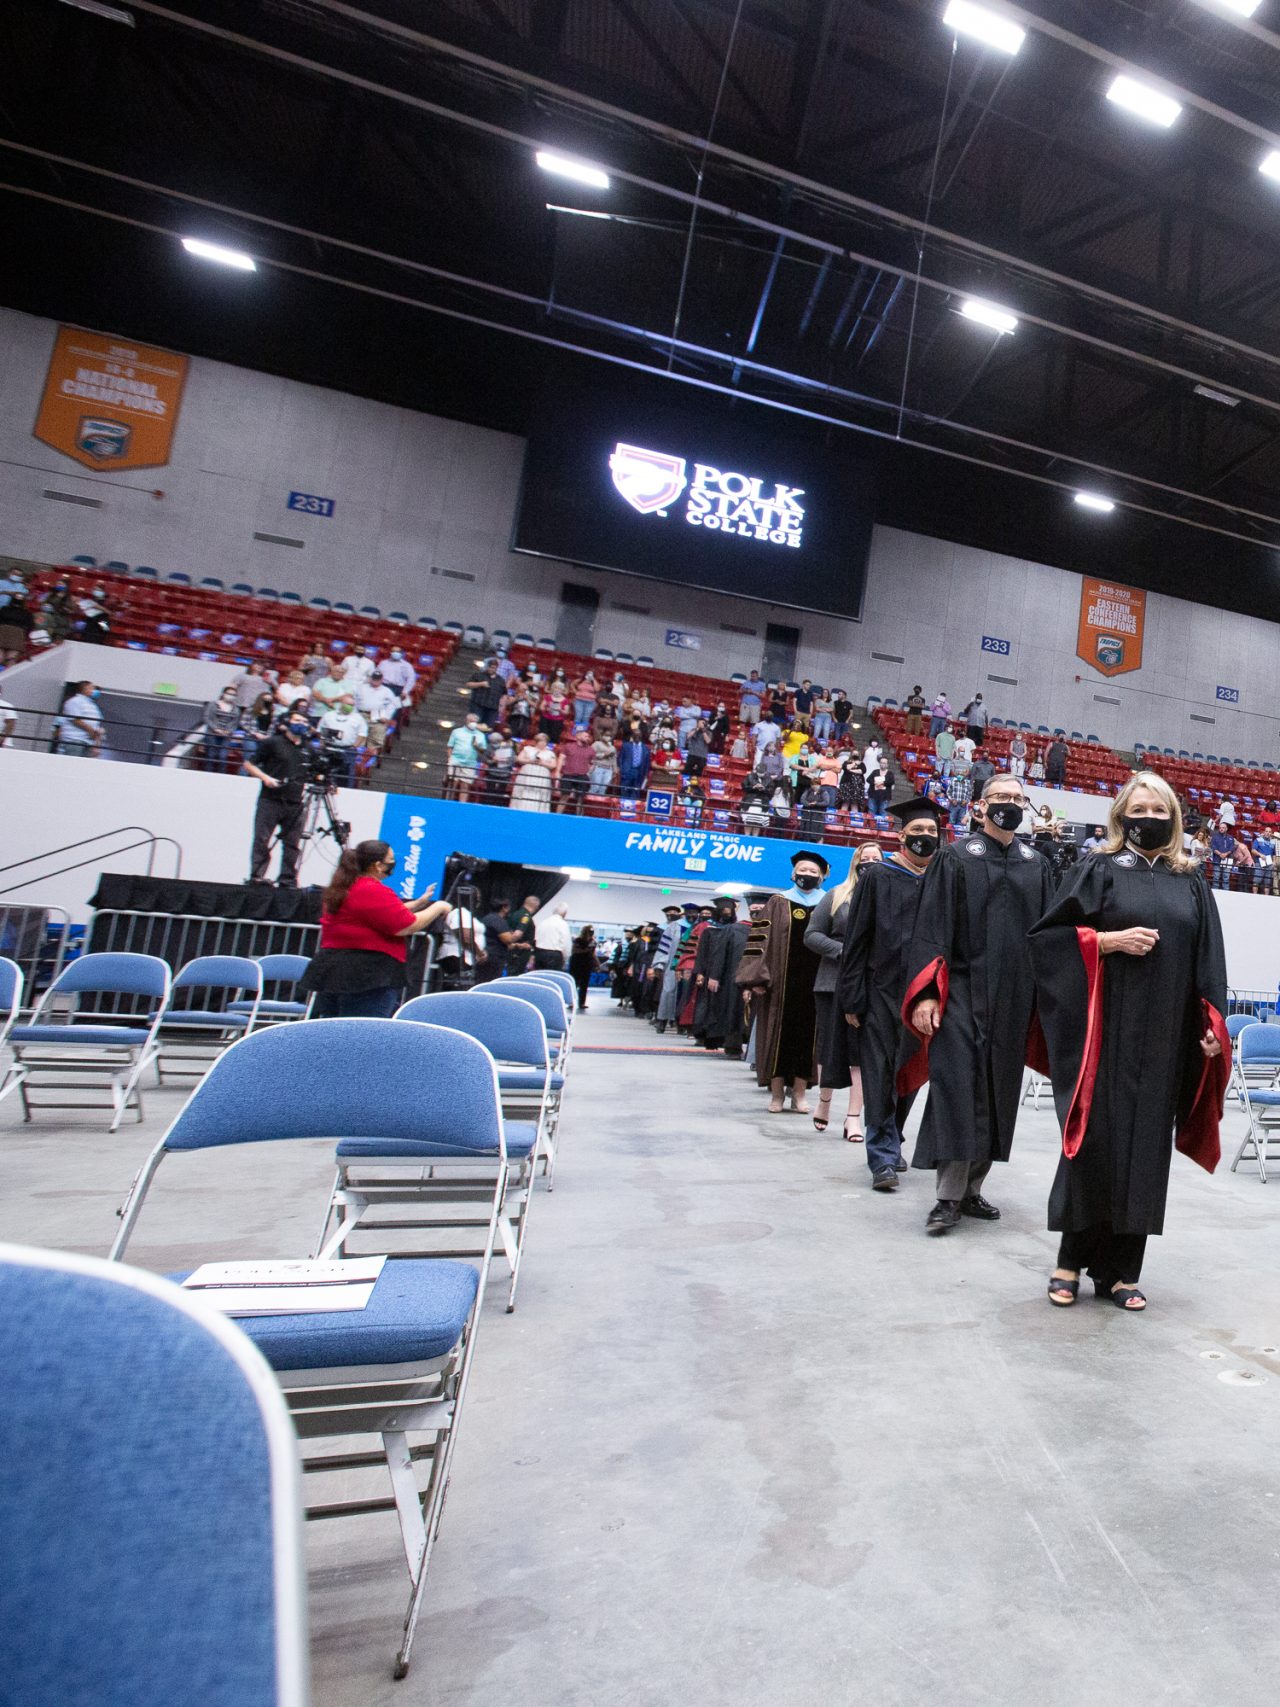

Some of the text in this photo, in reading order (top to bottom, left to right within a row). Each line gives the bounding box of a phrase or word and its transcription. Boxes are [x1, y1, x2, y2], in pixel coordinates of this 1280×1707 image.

[691, 463, 805, 513] POLK
[294, 495, 329, 514] 231
[687, 487, 804, 535] STATE
[686, 510, 802, 548] COLLEGE
[1088, 605, 1137, 625] CONFERENCE
[1097, 598, 1131, 614] EASTERN
[1087, 615, 1137, 634] CHAMPIONS
[984, 639, 1007, 653] 233
[1218, 688, 1237, 701] 234
[650, 797, 669, 810] 32
[655, 828, 740, 844] LAKELAND MAGIC
[625, 832, 765, 862] FAMILY ZONE
[404, 844, 421, 875] Blue
